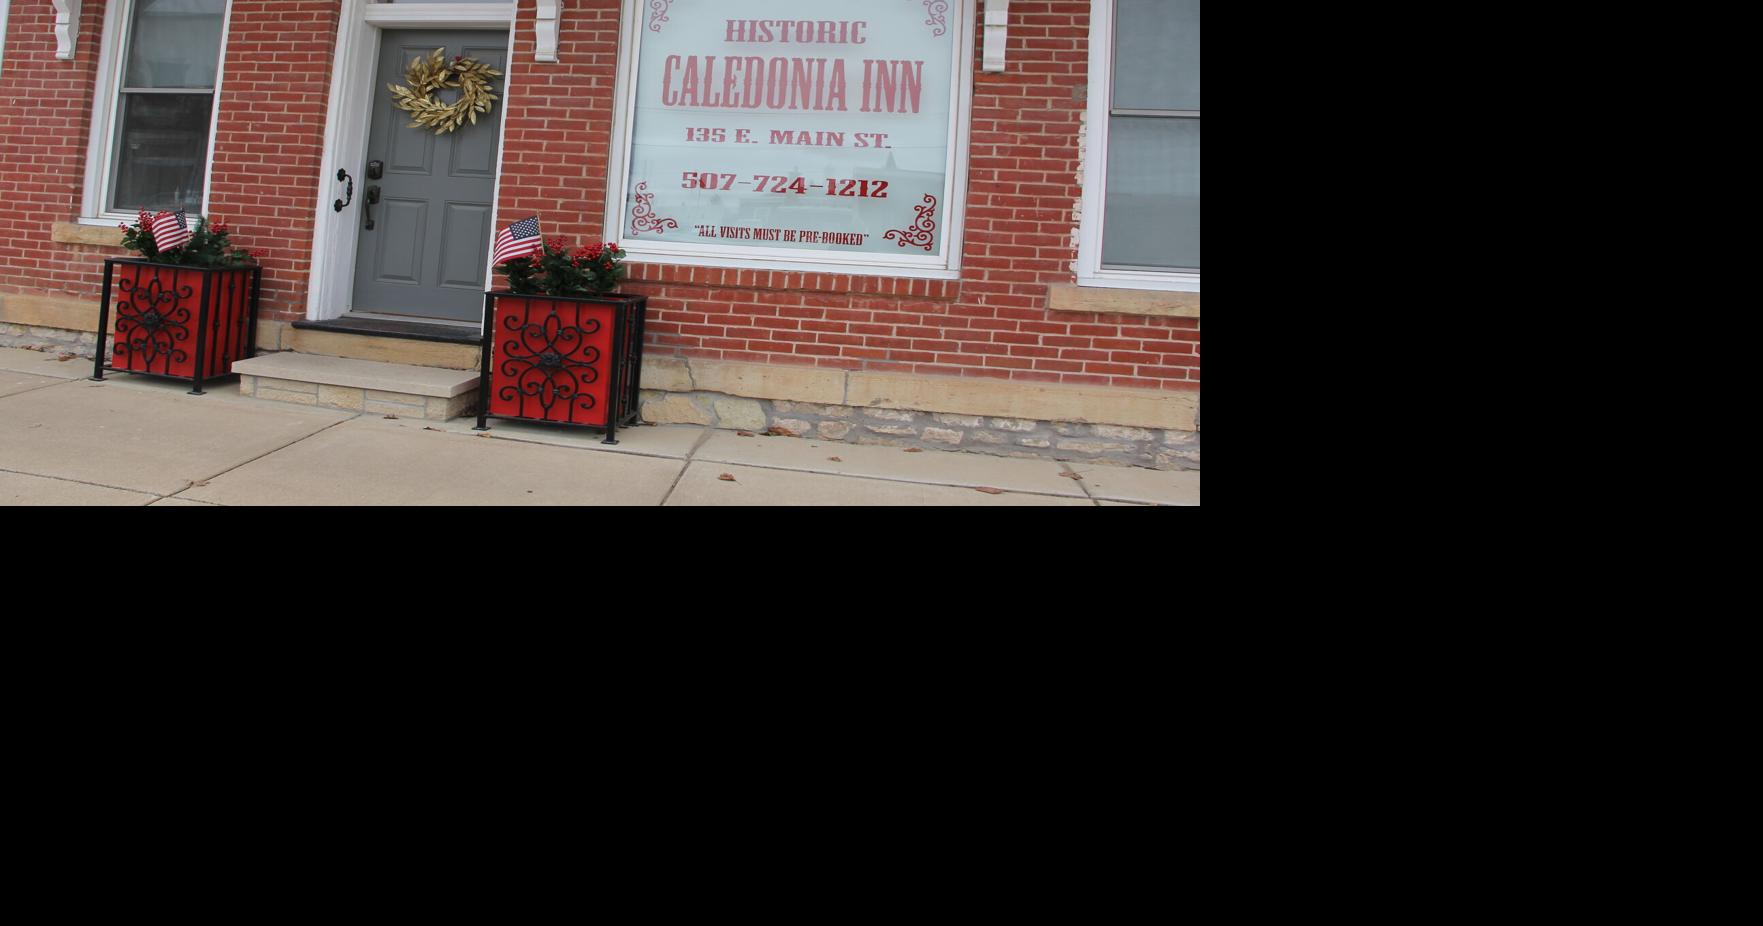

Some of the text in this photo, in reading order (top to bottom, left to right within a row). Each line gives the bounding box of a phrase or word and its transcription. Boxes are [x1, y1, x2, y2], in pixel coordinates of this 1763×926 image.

[724, 19, 867, 44] HISTORIC
[662, 54, 924, 113] CALEDONIA INN
[685, 127, 892, 149] 135 E. MAIN ST.
[681, 171, 889, 199] 507-724-1212
[720, 226, 750, 240] VISITS
[753, 228, 781, 241] MUST
[783, 229, 796, 242] BE
